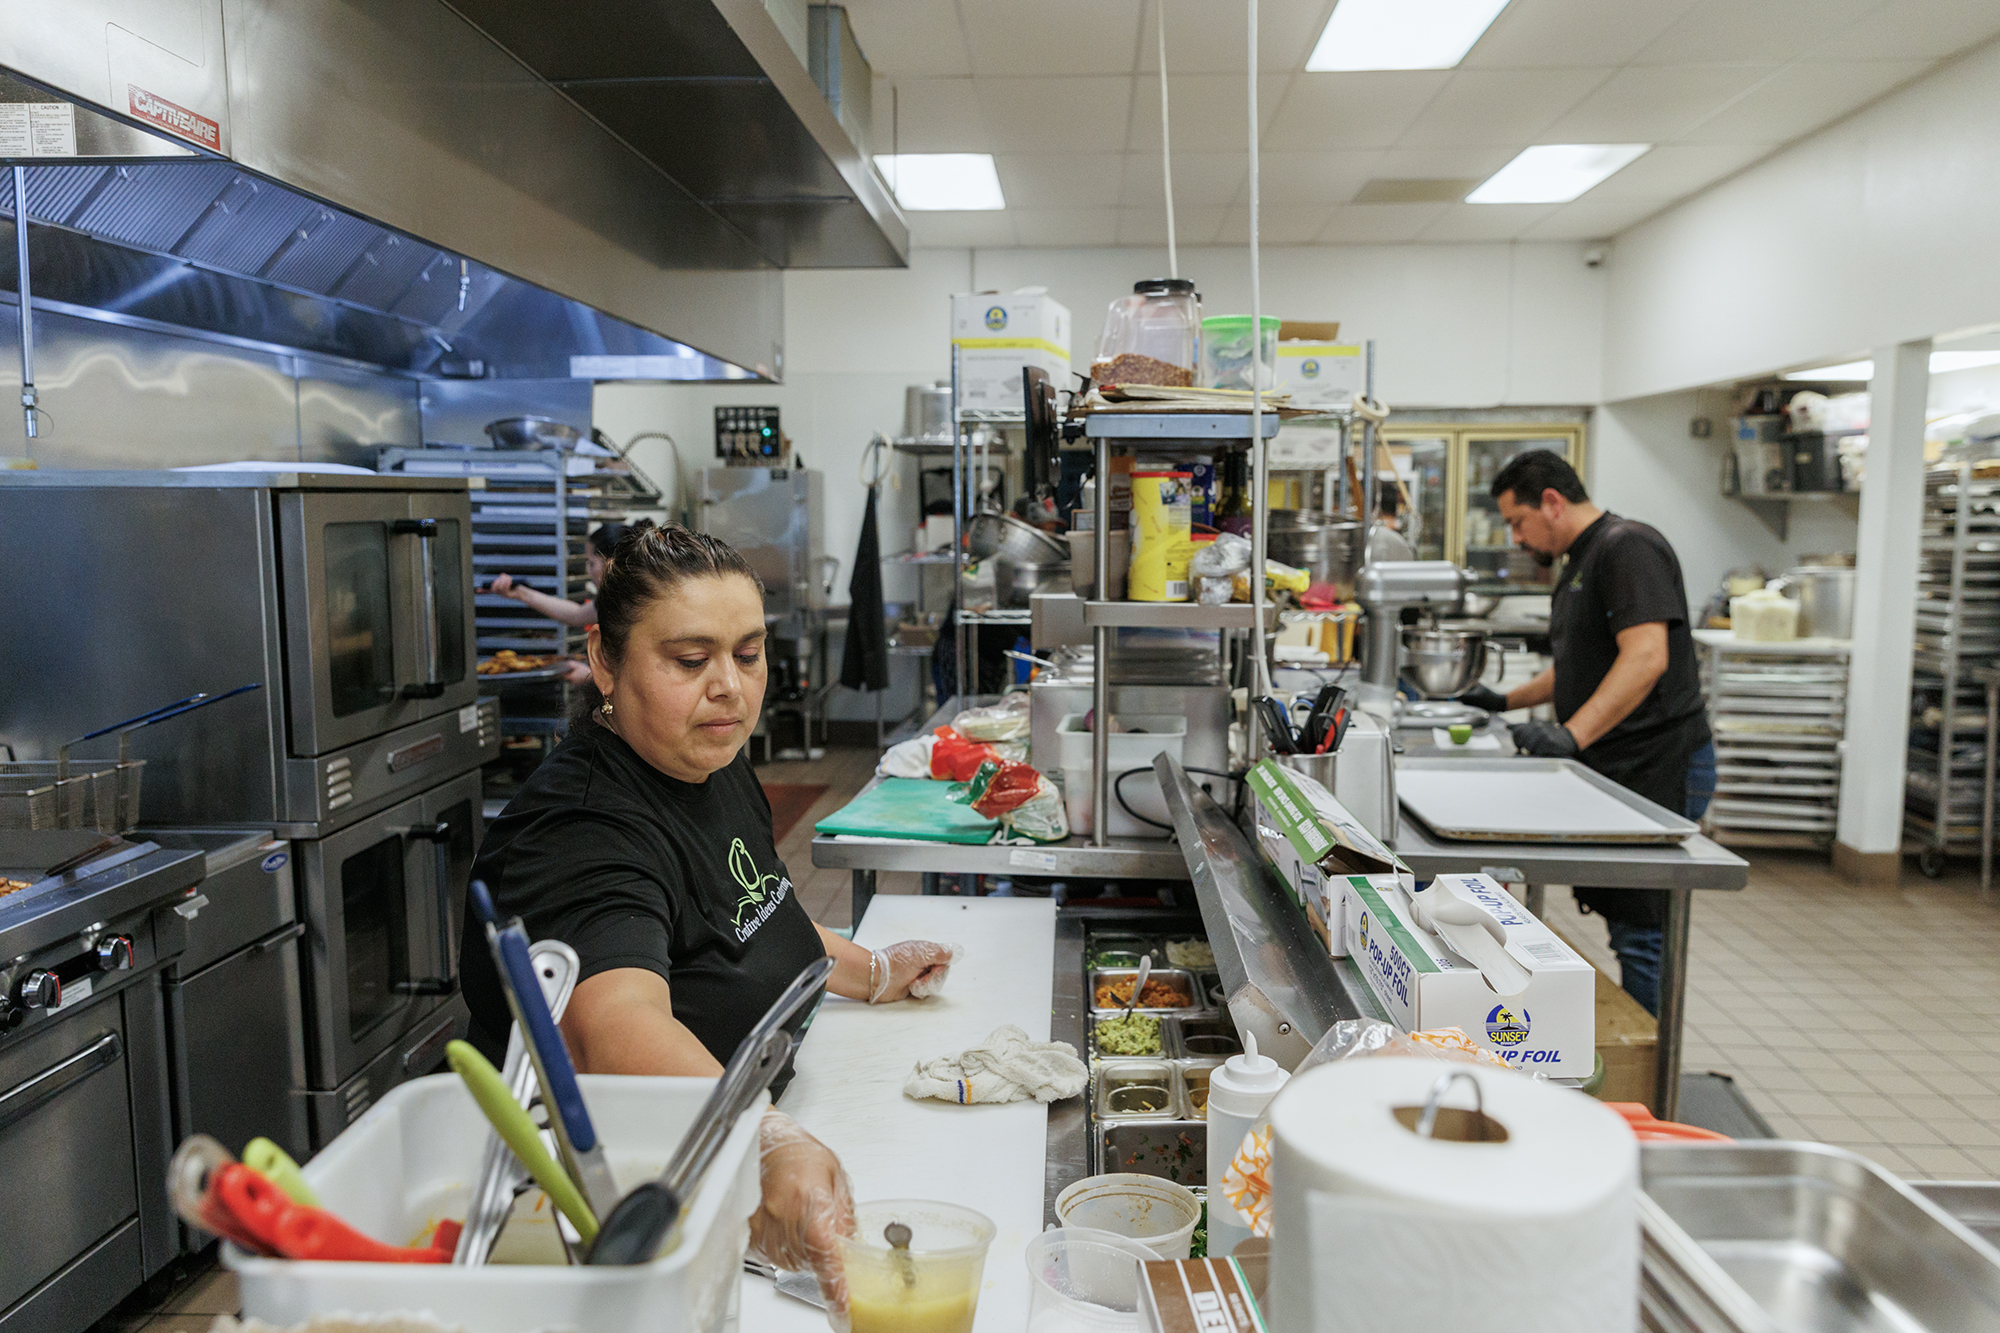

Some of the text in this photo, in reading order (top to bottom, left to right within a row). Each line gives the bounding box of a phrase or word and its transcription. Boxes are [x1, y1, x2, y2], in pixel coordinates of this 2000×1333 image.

[1460, 878, 1492, 894] FOIL
[755, 901, 777, 923] Ideas
[1477, 895, 1523, 926] POP-UP
[1369, 939, 1393, 979] POP-UP
[1392, 972, 1408, 1007] FOIL
[1390, 945, 1411, 982] 500CT
[1490, 1031, 1528, 1042] SUNSET
[1520, 1050, 1562, 1063] FOIL
